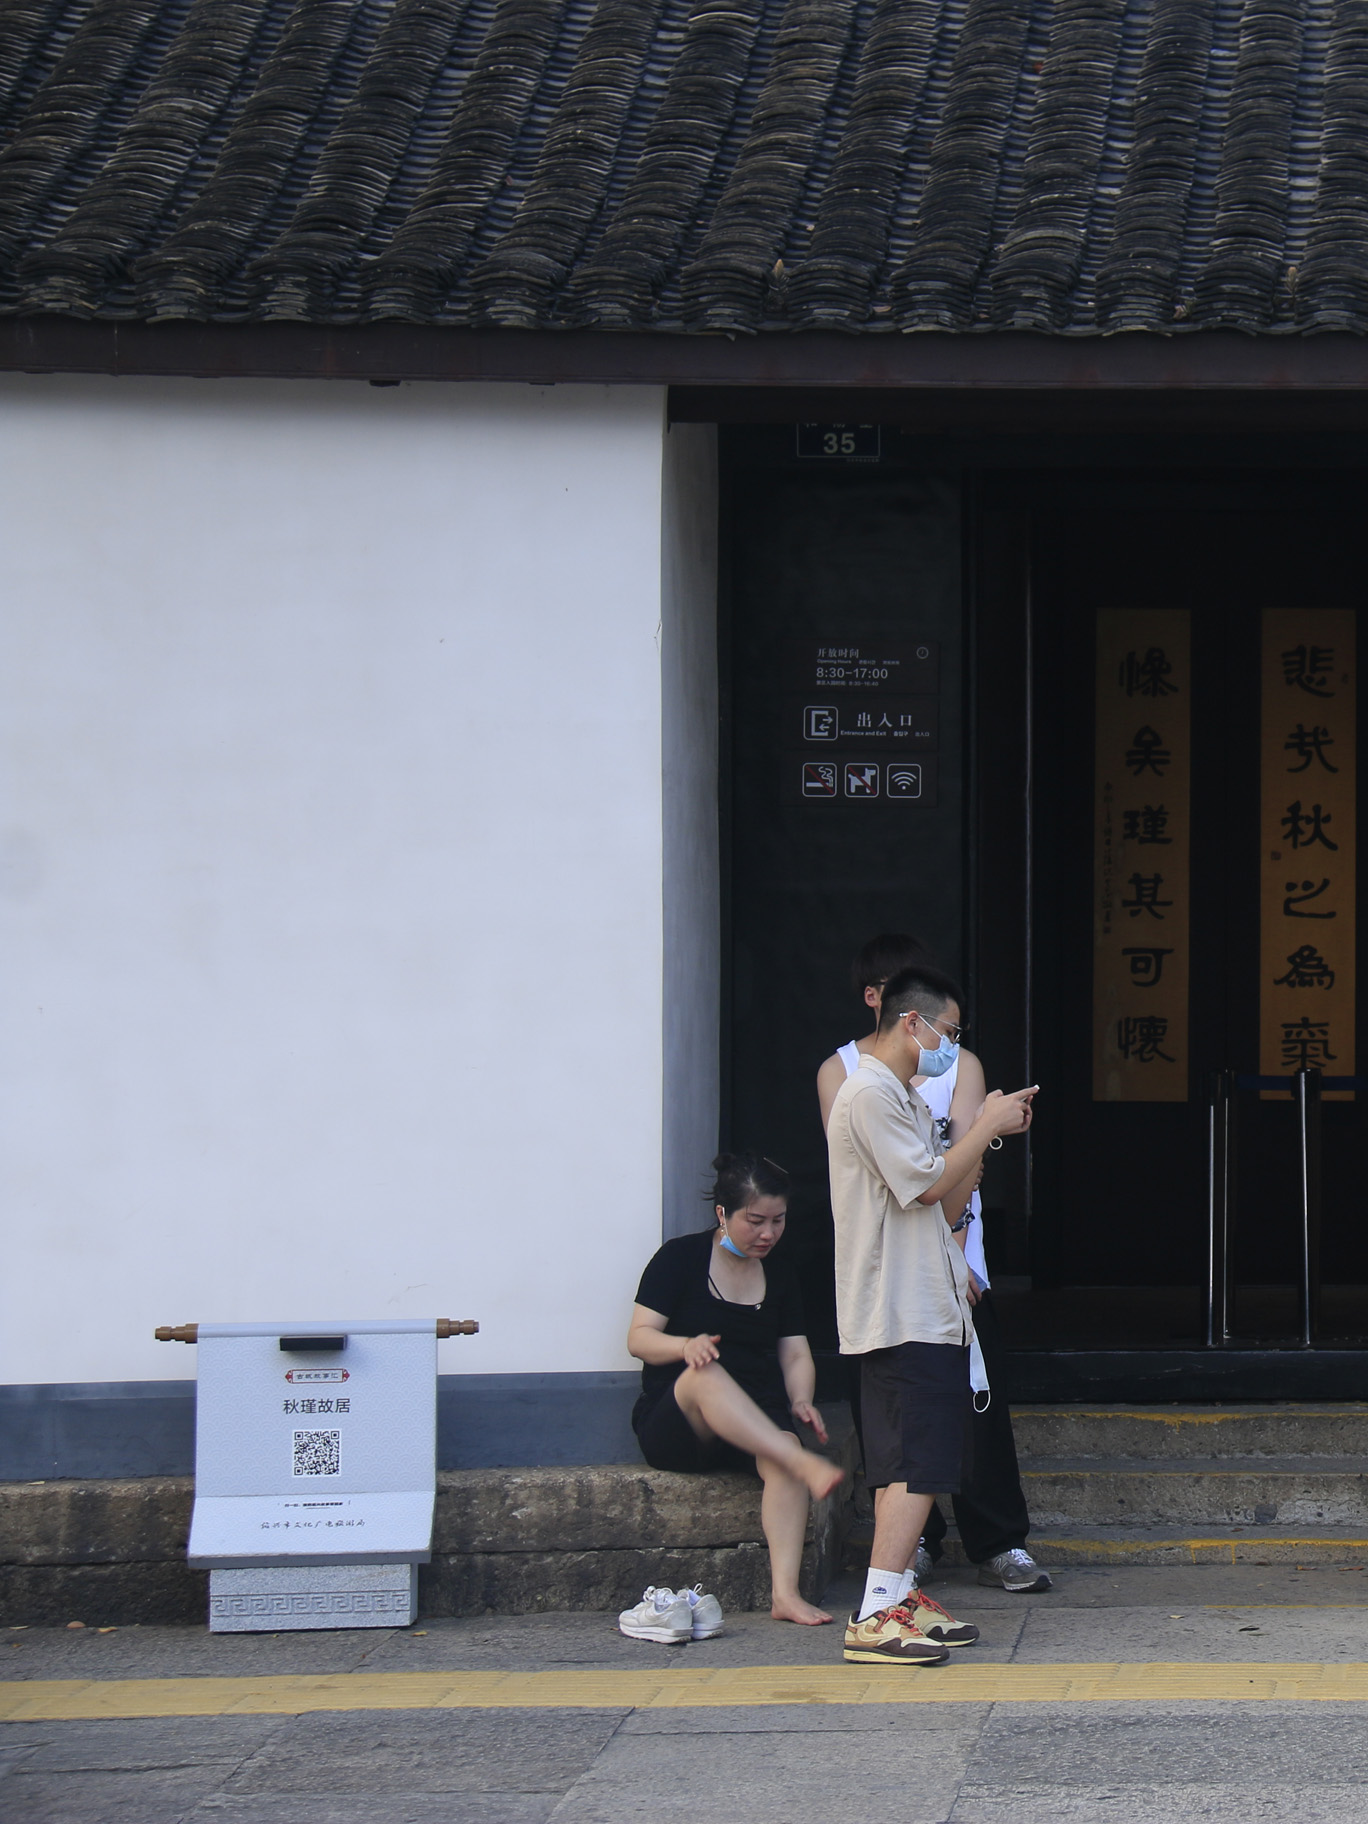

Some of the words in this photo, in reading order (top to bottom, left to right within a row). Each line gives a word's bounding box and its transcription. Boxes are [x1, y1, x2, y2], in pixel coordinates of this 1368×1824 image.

[823, 432, 856, 454] 35
[817, 648, 859, 659] 开放时间
[857, 712, 912, 728] 出入口
[283, 1398, 351, 1415] 秋瑾故居
